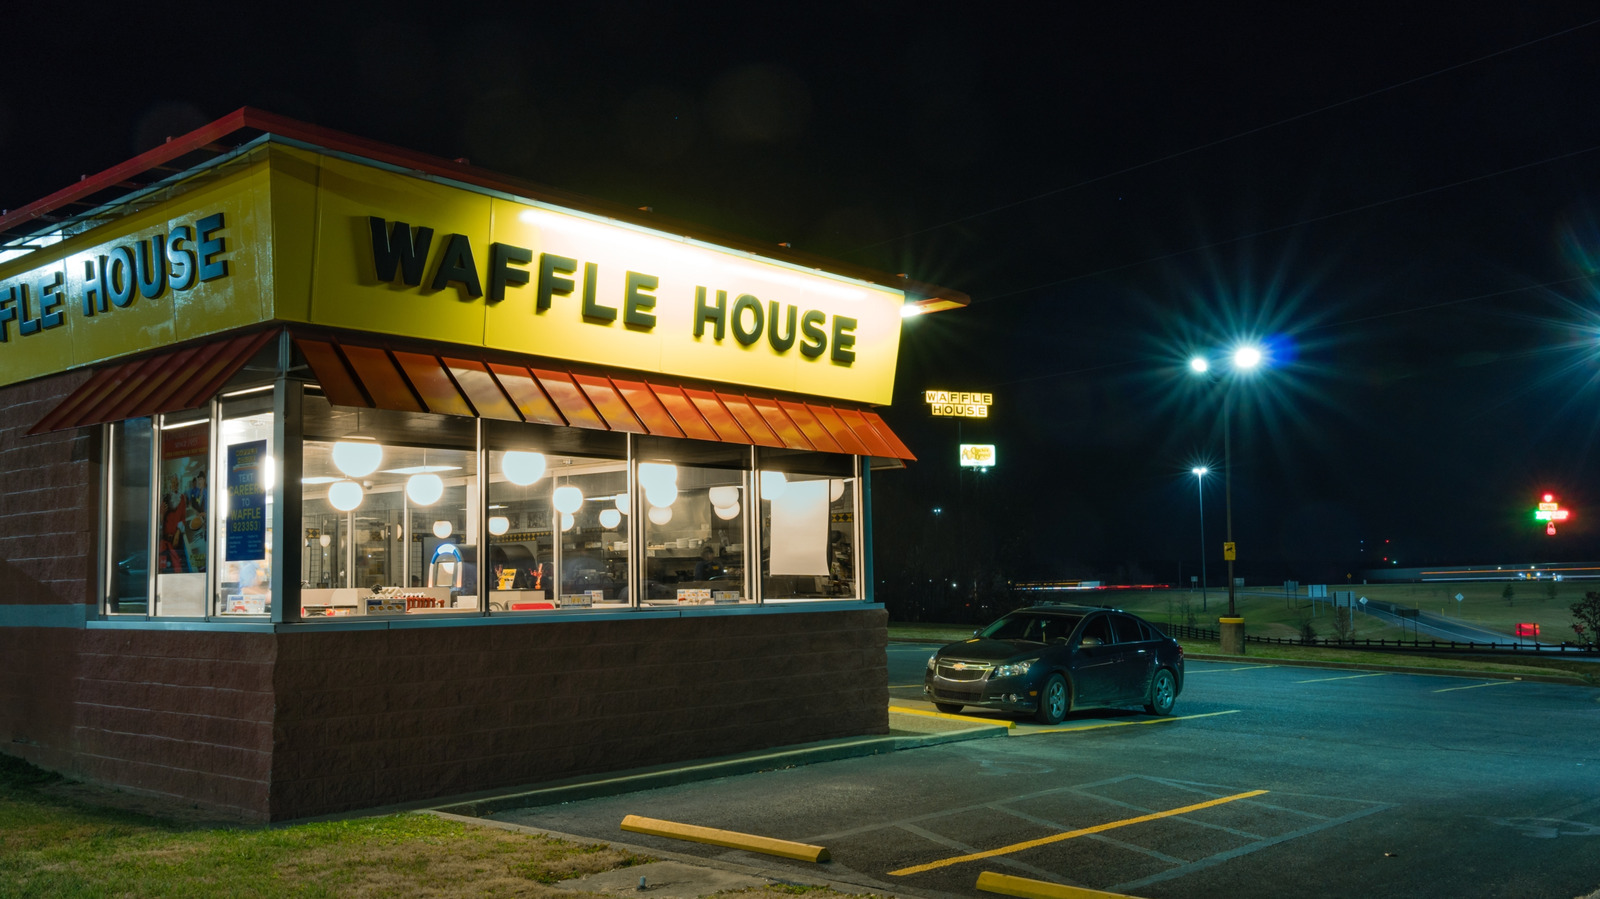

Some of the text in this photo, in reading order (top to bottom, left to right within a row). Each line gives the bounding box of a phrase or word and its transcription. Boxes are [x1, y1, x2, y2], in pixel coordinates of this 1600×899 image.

[82, 212, 228, 316] HOUSE
[369, 215, 858, 363] WAFFLE HOUSE
[927, 392, 991, 403] WAFFLE
[933, 405, 986, 415] HOUSE
[238, 473, 253, 483] TEXT
[242, 498, 250, 507] TO
[230, 507, 261, 520] WAFFLE
